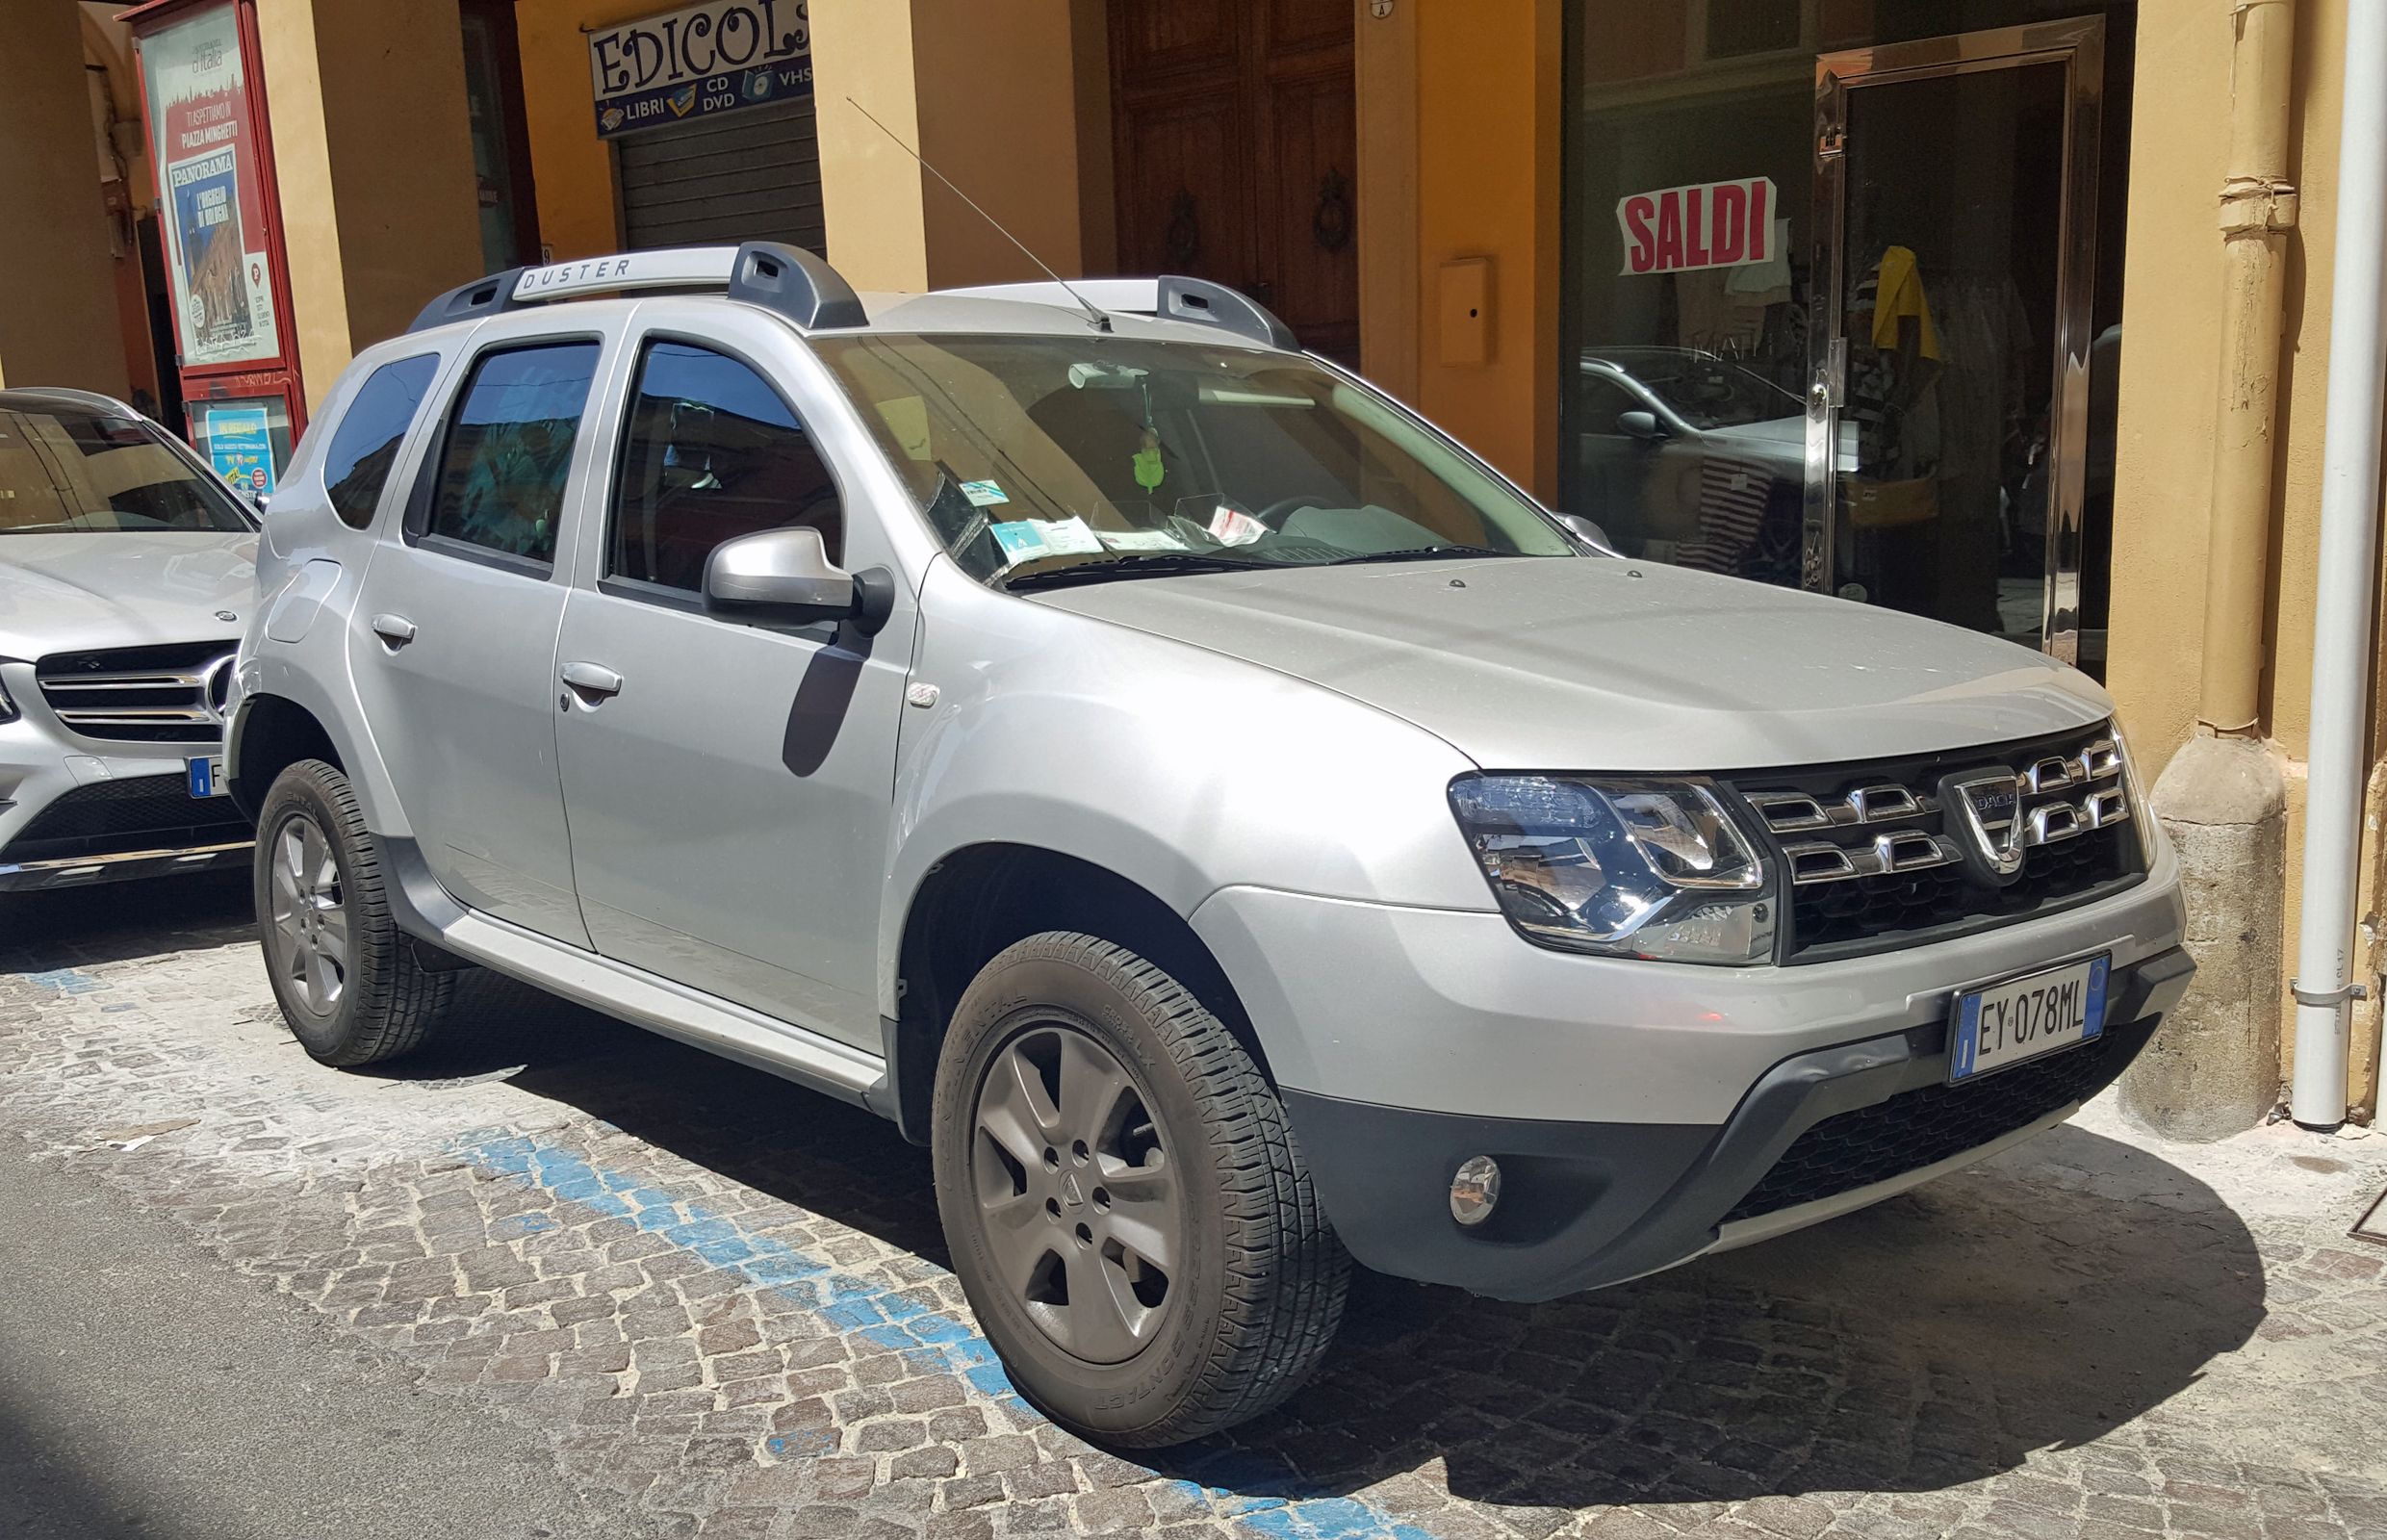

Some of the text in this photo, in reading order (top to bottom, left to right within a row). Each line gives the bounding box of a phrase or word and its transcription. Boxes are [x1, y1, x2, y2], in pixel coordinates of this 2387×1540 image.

[706, 76, 729, 93] CD
[779, 67, 813, 87] VHS
[627, 97, 664, 120] LIBRI
[703, 93, 735, 113] DVD
[182, 120, 238, 149] PIAZZA MINGHETTI
[173, 154, 233, 188] PANORAMA
[1625, 180, 1766, 273] SALDI
[524, 260, 629, 289] DUSTER
